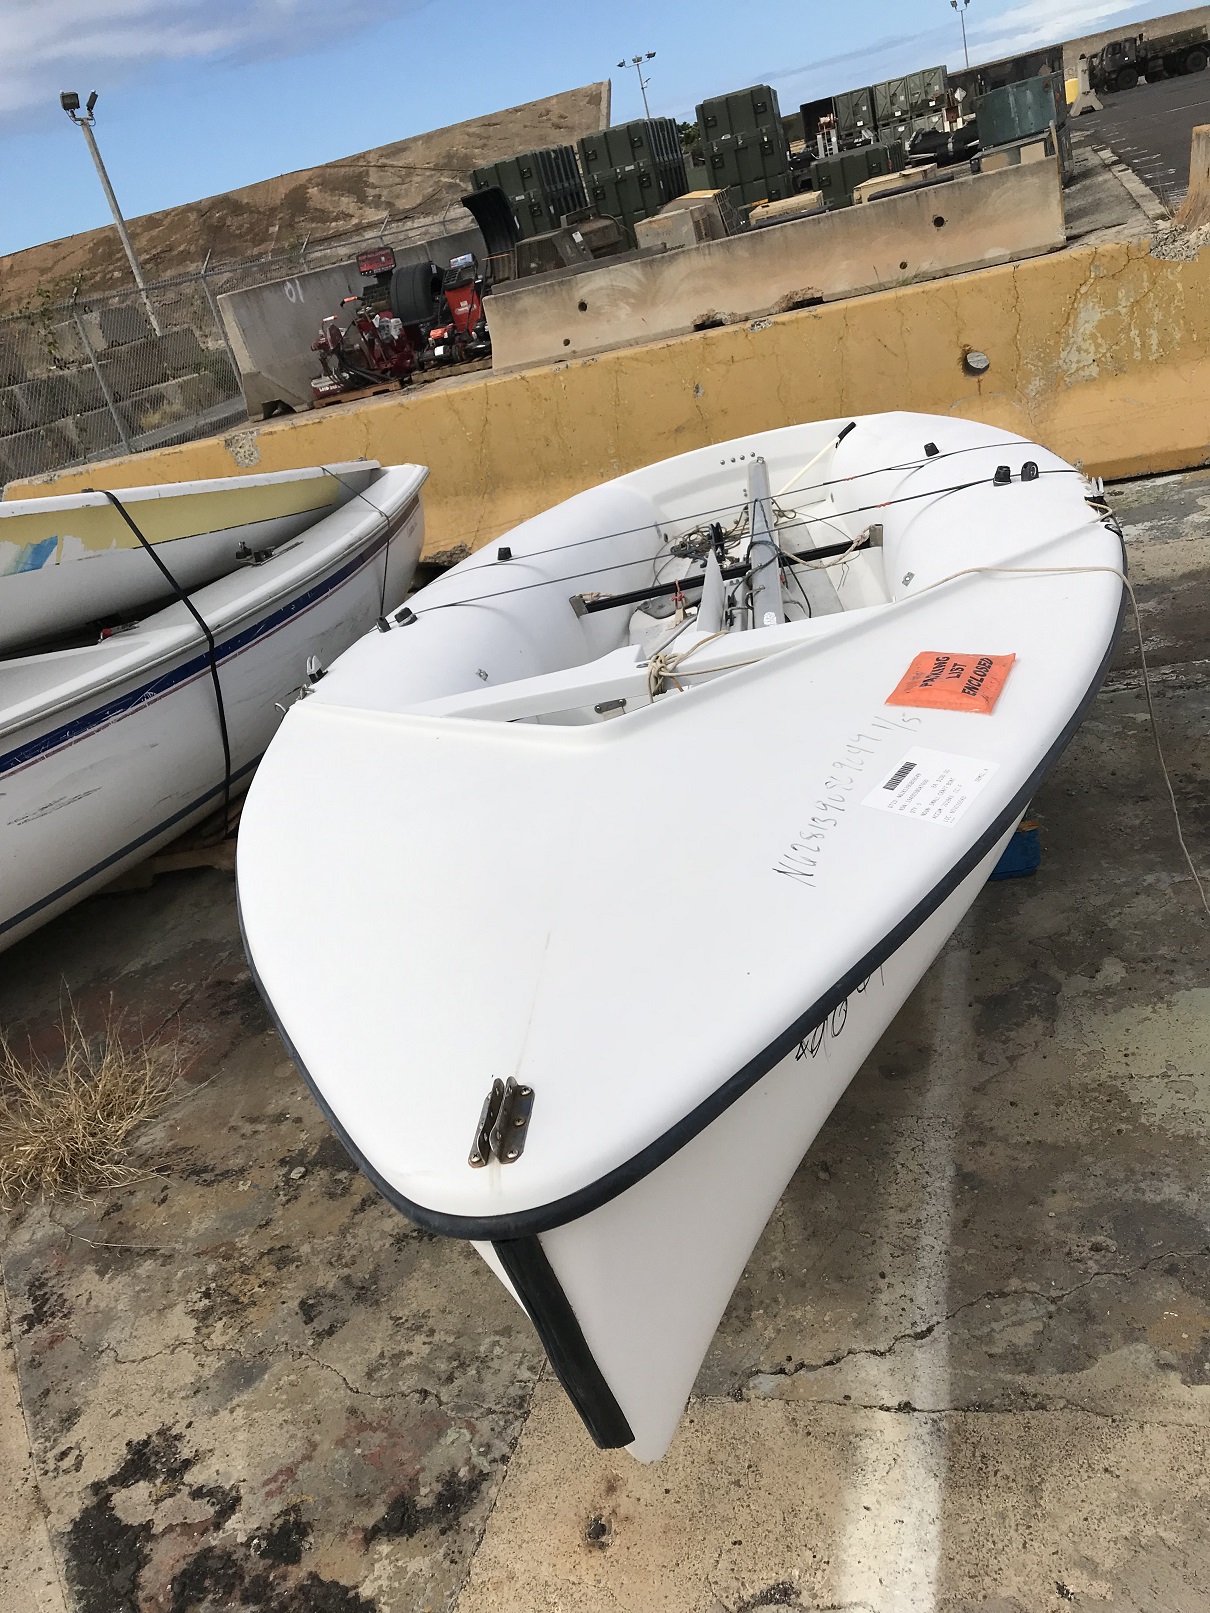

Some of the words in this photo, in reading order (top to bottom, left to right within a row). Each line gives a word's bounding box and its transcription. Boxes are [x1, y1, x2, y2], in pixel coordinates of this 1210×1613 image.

[919, 656, 950, 688] PACKING
[946, 663, 967, 679] LIST
[961, 657, 994, 696] ENCLOSED
